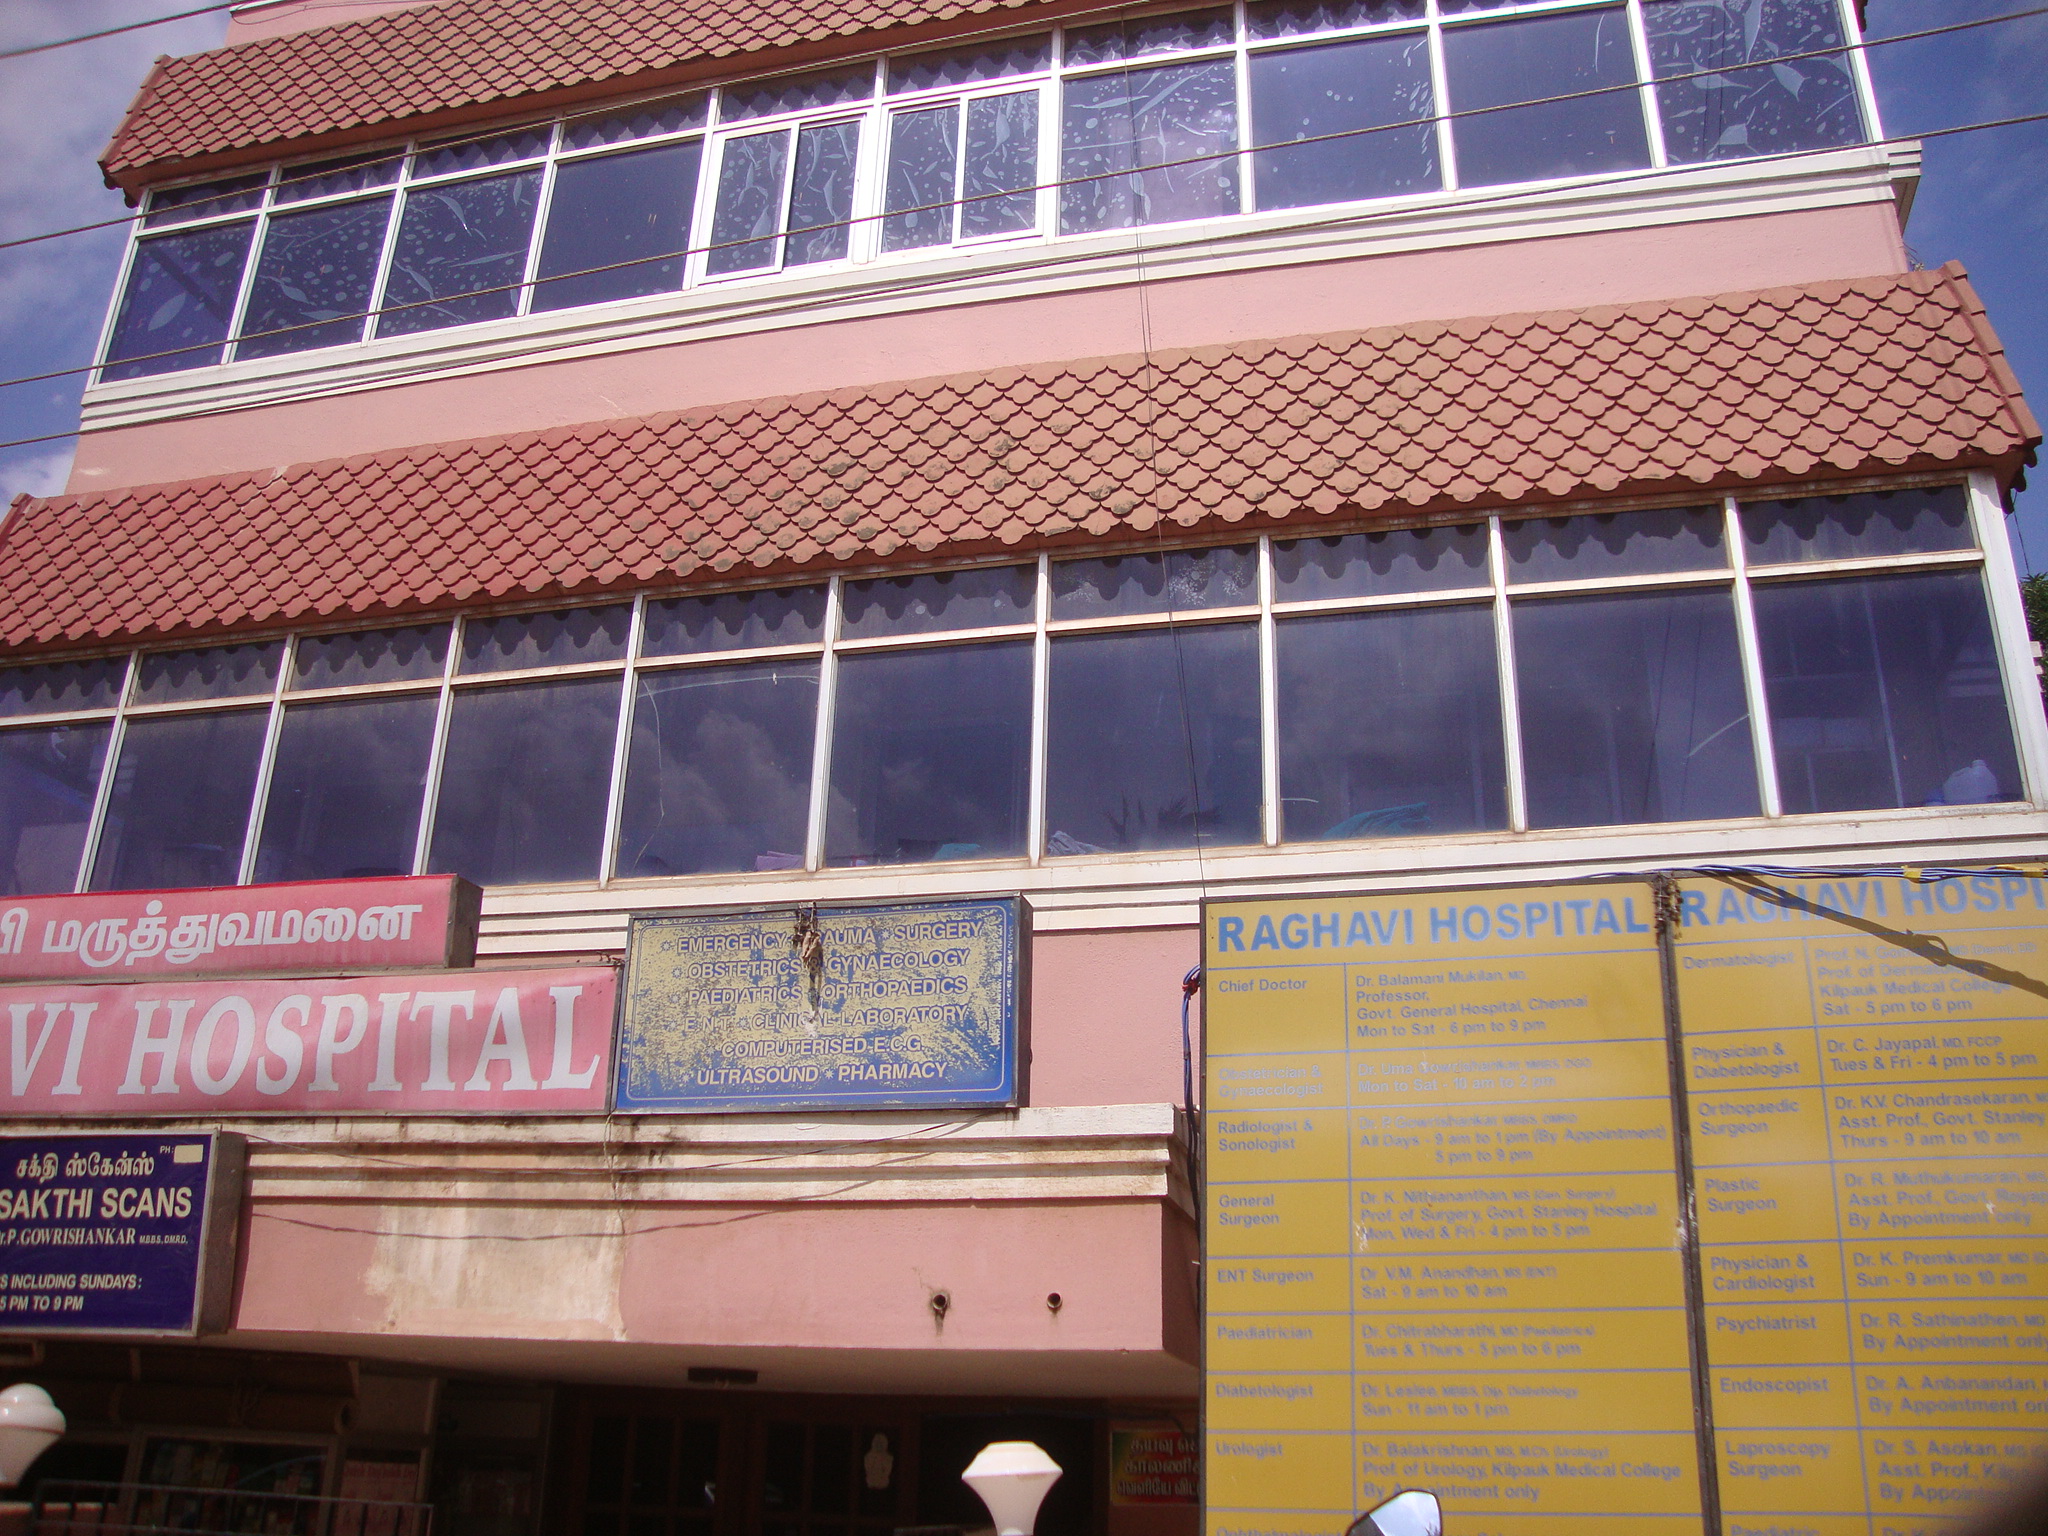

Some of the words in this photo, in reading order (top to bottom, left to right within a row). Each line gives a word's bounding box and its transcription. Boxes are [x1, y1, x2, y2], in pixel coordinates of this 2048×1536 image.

[1681, 879, 1888, 929] RAGHAVI
[1902, 876, 2048, 917] HOSPI
[41, 900, 423, 968] மருத்துவமனை
[1217, 909, 1414, 953] RAGHAVI
[1429, 896, 1650, 944] HOSPITAL
[677, 933, 787, 953] EMERGENCY
[893, 921, 983, 940] SURGERY
[688, 958, 801, 978] OBSTETRICS
[828, 948, 970, 974] GYNAECOLOGY
[1218, 980, 1255, 993] Chief
[1259, 978, 1308, 991] Doctor
[1356, 975, 1374, 987] Dr.
[1379, 972, 1444, 987] Balamani
[1883, 980, 1945, 995] Medical
[688, 985, 803, 1005] PAEDIATRICS
[821, 976, 968, 1000] ORTHOPAEDICS
[841, 1005, 968, 1027] LABORATORY
[1356, 1007, 1395, 1021] Govt.
[1400, 1004, 1456, 1018] General
[1528, 995, 1588, 1010] Chennai
[1823, 1002, 1849, 1016] Sat
[1880, 1000, 1906, 1016] pm
[1911, 999, 1927, 1012] to
[1947, 999, 1972, 1014] pm
[1356, 1025, 1387, 1038] Mon
[1391, 1024, 1407, 1036] to
[1411, 1023, 1435, 1036] Sat
[1450, 1022, 1458, 1034] 6
[1463, 1022, 1486, 1036] pm
[1491, 1020, 1506, 1033] to
[1509, 1019, 1519, 1031] 9
[1523, 1020, 1546, 1033] pm
[117, 985, 601, 1096] HOSPITAL
[721, 1038, 867, 1059] COMPUTERISED
[1380, 1062, 1414, 1075] Uma
[1830, 1057, 1868, 1073] Tues
[1873, 1055, 1886, 1071] &
[1890, 1054, 1913, 1069] Fri
[1943, 1053, 1969, 1072] pm
[1973, 1053, 1992, 1067] to
[2010, 1052, 2037, 1069] pm
[697, 1066, 820, 1086] ULTRASOUND
[838, 1061, 948, 1082] PHARMACY
[1218, 1066, 1306, 1082] Obstetrician
[1218, 1082, 1324, 1101] Gynaecologist
[1358, 1080, 1390, 1093] Mon
[1394, 1079, 1409, 1092] to
[1413, 1078, 1438, 1091] Sat
[1472, 1078, 1495, 1090] am
[1500, 1076, 1515, 1088] to
[1519, 1075, 1528, 1088] 2
[1532, 1075, 1555, 1090] pm
[1698, 1099, 1801, 1118] Orthopaedic
[1983, 1109, 2046, 1126] Stanley
[1218, 1119, 1298, 1135] Radiologist
[1303, 1119, 1314, 1131] &
[1700, 1121, 1769, 1138] Surgeon
[1218, 1138, 1296, 1153] Sonologist
[1383, 1133, 1419, 1150] Days
[1475, 1132, 1490, 1144] to
[1840, 1134, 1888, 1149] Thurs
[1904, 1132, 1914, 1146] 9
[1920, 1133, 1946, 1146] am
[1950, 1132, 1967, 1145] to
[1995, 1131, 2022, 1144] am
[16, 1152, 59, 1184] சக்தி
[65, 1150, 155, 1178] ஸ்கேன்ஸ்
[1705, 1177, 1760, 1192] Plastic
[0, 1187, 94, 1220] SAKTHI
[100, 1186, 193, 1219] SCANS
[1219, 1194, 1275, 1208] General
[1707, 1197, 1777, 1214] Surgeon
[1219, 1212, 1280, 1228] Surgeon
[1711, 1255, 1791, 1274] Physician
[1796, 1254, 1808, 1269] &
[11, 1273, 77, 1290] INCLUDING
[1217, 1269, 1247, 1283] ENT
[1252, 1268, 1314, 1285] Surgeon
[1713, 1274, 1816, 1293] Cardiologist
[1857, 1272, 1889, 1287] Sun
[9, 1295, 29, 1312] PM
[32, 1295, 51, 1312] TO
[53, 1296, 62, 1311] 9
[64, 1295, 85, 1312] PM
[1716, 1315, 1817, 1335] Psychiatrist
[1215, 1383, 1313, 1401] Diabetologist
[1720, 1376, 1829, 1396] Endoscopist
[1215, 1441, 1283, 1460] Urologist
[1725, 1440, 1831, 1459] Laproscopy
[1555, 1463, 1616, 1477] Medical
[1728, 1461, 1803, 1480] Surgeon
